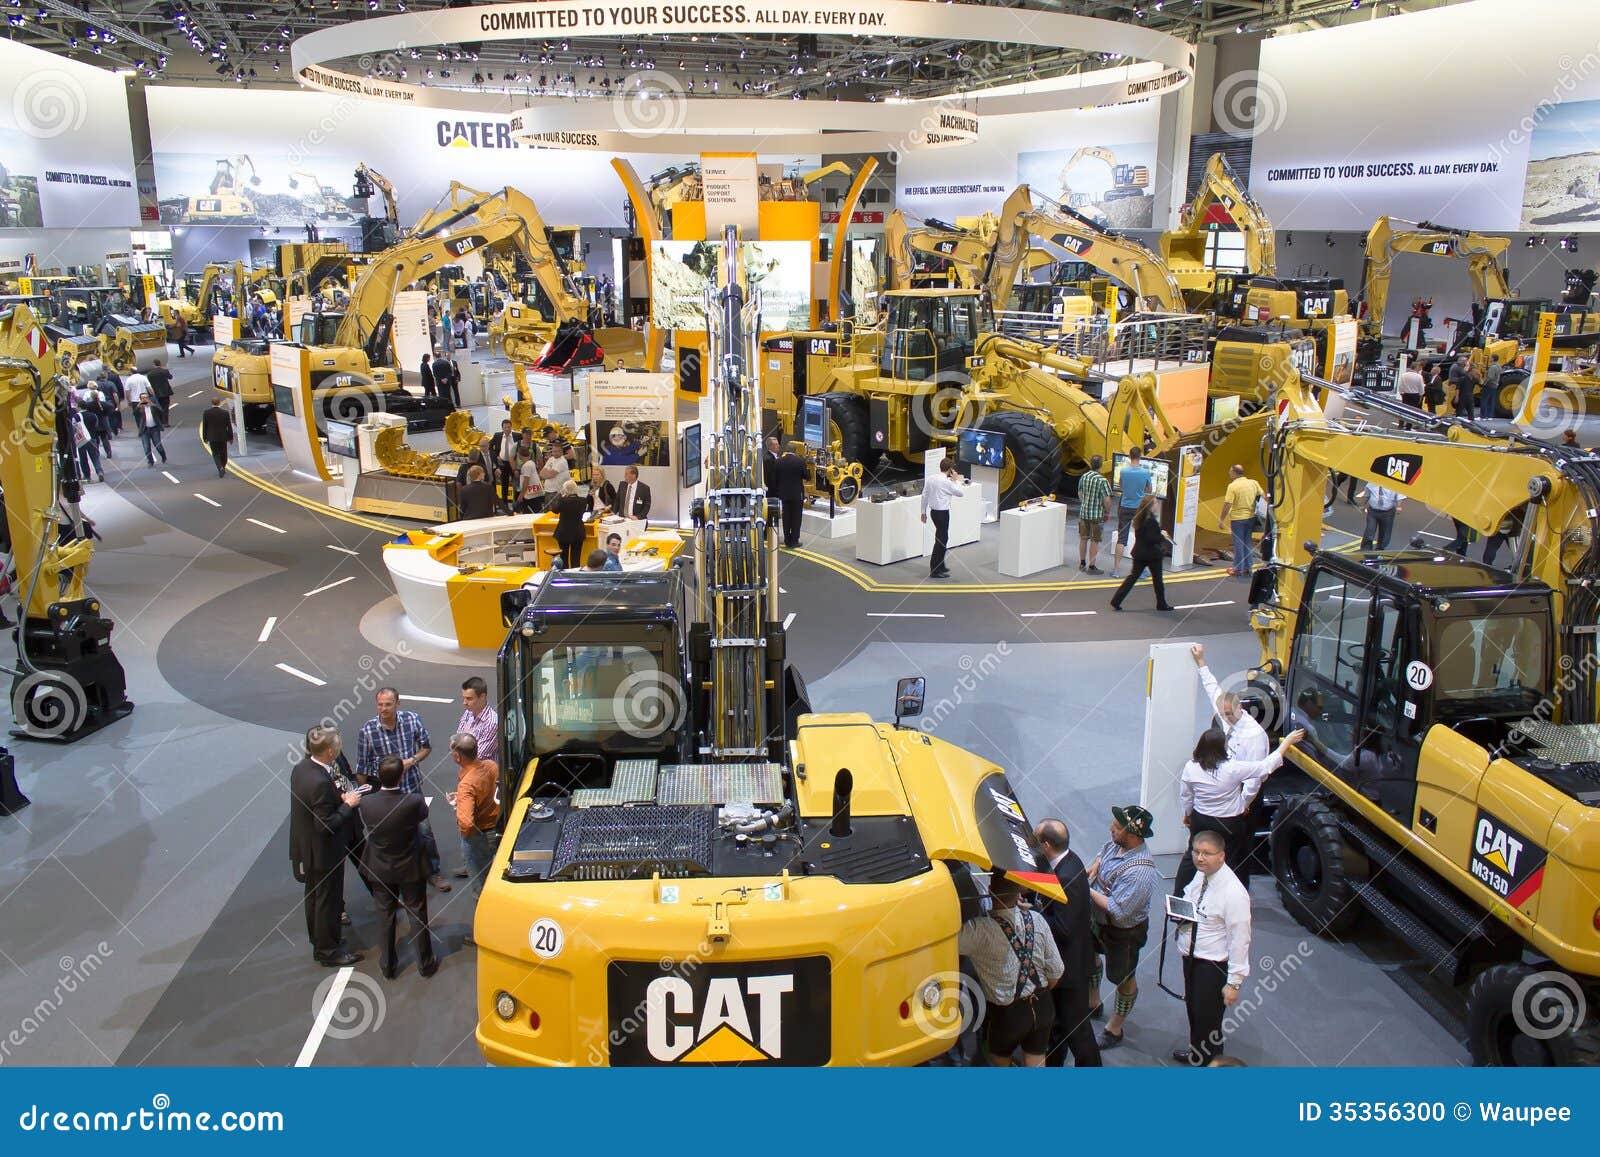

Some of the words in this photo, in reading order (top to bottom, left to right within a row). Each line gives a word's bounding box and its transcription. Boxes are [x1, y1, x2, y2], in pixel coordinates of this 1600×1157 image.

[481, 10, 578, 31] COMMITTED
[582, 8, 604, 26] TO
[610, 6, 658, 25] YOUR
[662, 4, 750, 24] SUCCESS.
[756, 10, 779, 23] ALL
[782, 10, 811, 24] DAY.
[814, 11, 856, 25] EVERY
[859, 12, 886, 26] DAY.
[1128, 78, 1160, 96] COMMITTED
[561, 132, 600, 146] SUCCESS.
[1267, 167, 1320, 181] COMMITTED
[1324, 166, 1336, 179] TO
[1338, 165, 1364, 178] YOUR
[1366, 162, 1416, 178] SUCCESS.
[1418, 165, 1432, 175] ALL
[1434, 164, 1450, 175] DAY.
[1452, 163, 1478, 174] EVERY
[1480, 162, 1498, 172] DAY.
[456, 236, 474, 254] CAT
[942, 242, 953, 253] CAT
[1063, 235, 1083, 253] CAT
[1433, 242, 1448, 255] CAT
[1304, 298, 1329, 315] CAT
[1544, 319, 1552, 338] NEW
[811, 339, 831, 355] CAT
[215, 364, 229, 387] CAT
[336, 375, 352, 387] CAT
[1387, 456, 1410, 482] CAT
[1410, 666, 1426, 685] 20
[988, 787, 1026, 822] CAT
[1475, 817, 1523, 877] CAT
[1471, 858, 1509, 896] M313D
[536, 925, 556, 952] 20
[646, 974, 793, 1062] CAT
